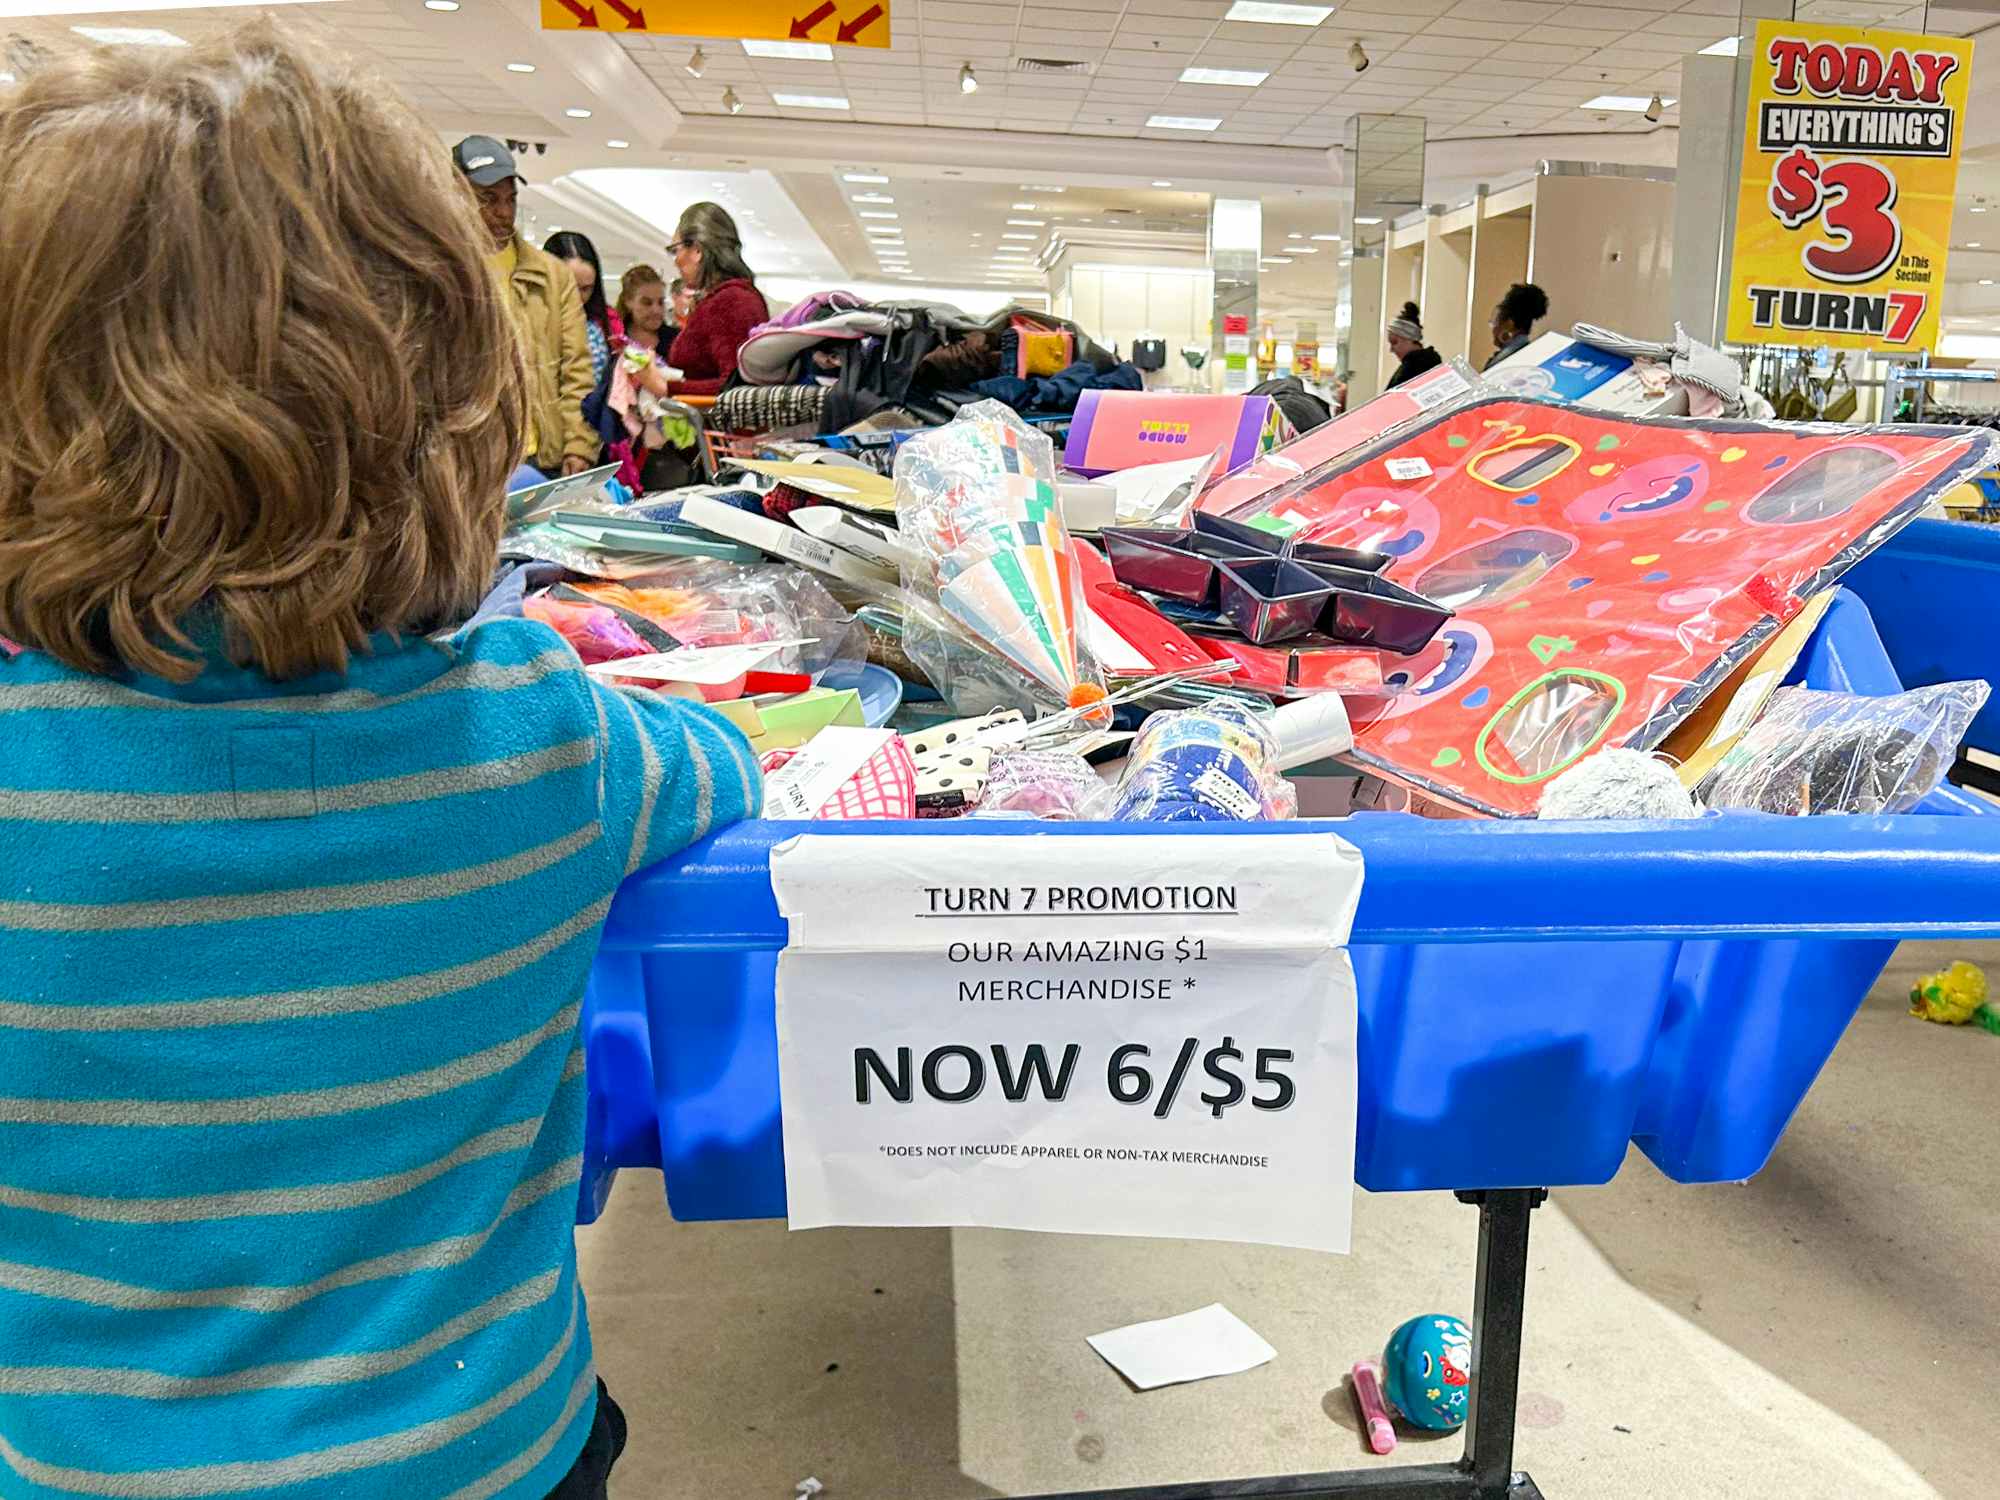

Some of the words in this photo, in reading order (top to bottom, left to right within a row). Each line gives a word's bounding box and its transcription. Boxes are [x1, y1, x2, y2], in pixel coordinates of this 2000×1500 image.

[1769, 38, 1957, 103] TODAY
[1766, 107, 1946, 146] EVERYTHING'S
[1771, 148, 1897, 277] $3
[1900, 255, 1909, 267] In
[1911, 256, 1929, 268] This
[1895, 268, 1931, 283] Section!
[1138, 431, 1187, 444] MONDO
[786, 783, 807, 808] TURN
[924, 887, 1010, 912] TURN
[1020, 887, 1037, 911] 7
[1048, 886, 1237, 912] PROMOTION
[947, 941, 1013, 963] OUR
[1023, 939, 1165, 963] AMAZING
[1174, 935, 1208, 963] $1
[958, 979, 1174, 1002] MERCHANDISE
[854, 1043, 1081, 1105] NOW
[1107, 1036, 1296, 1119] 6/$5
[927, 1145, 956, 1157] NOT
[960, 1145, 1018, 1157] INCLUDE
[1021, 1146, 1080, 1160] APPAREL
[1083, 1148, 1102, 1160] OR
[1105, 1149, 1168, 1163] NON-TAX
[1172, 1151, 1269, 1168] MERCHANDISE
